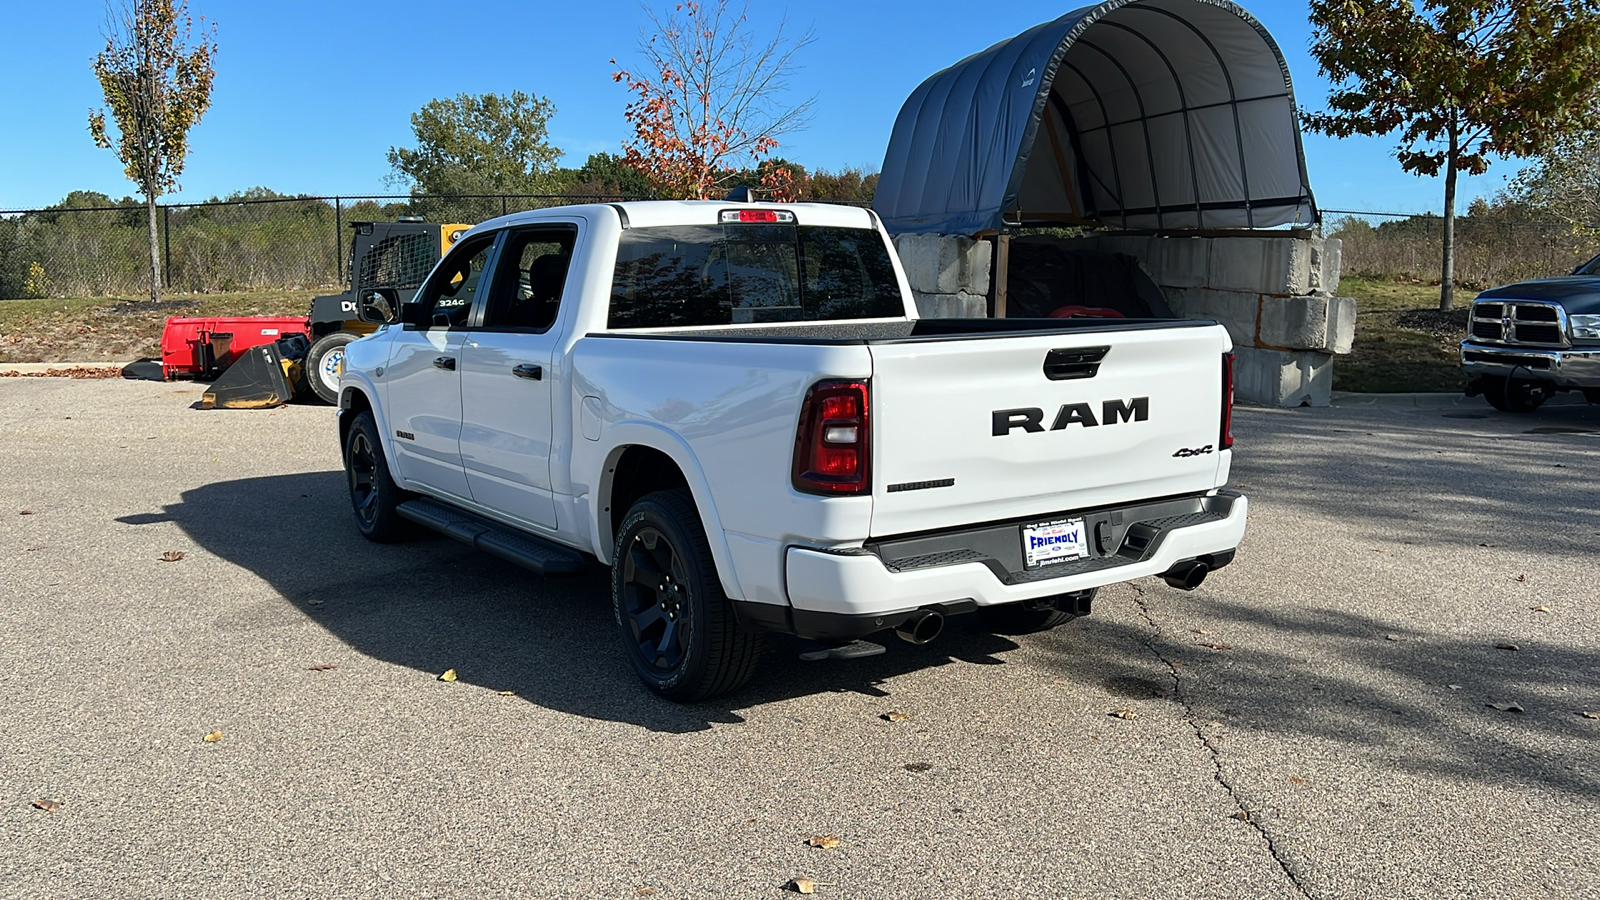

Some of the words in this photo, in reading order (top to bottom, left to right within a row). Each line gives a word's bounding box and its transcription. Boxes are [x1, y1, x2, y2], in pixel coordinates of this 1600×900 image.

[439, 299, 465, 307] 324G
[992, 396, 1149, 437] RAM
[1030, 529, 1078, 550] FRIENDLY
